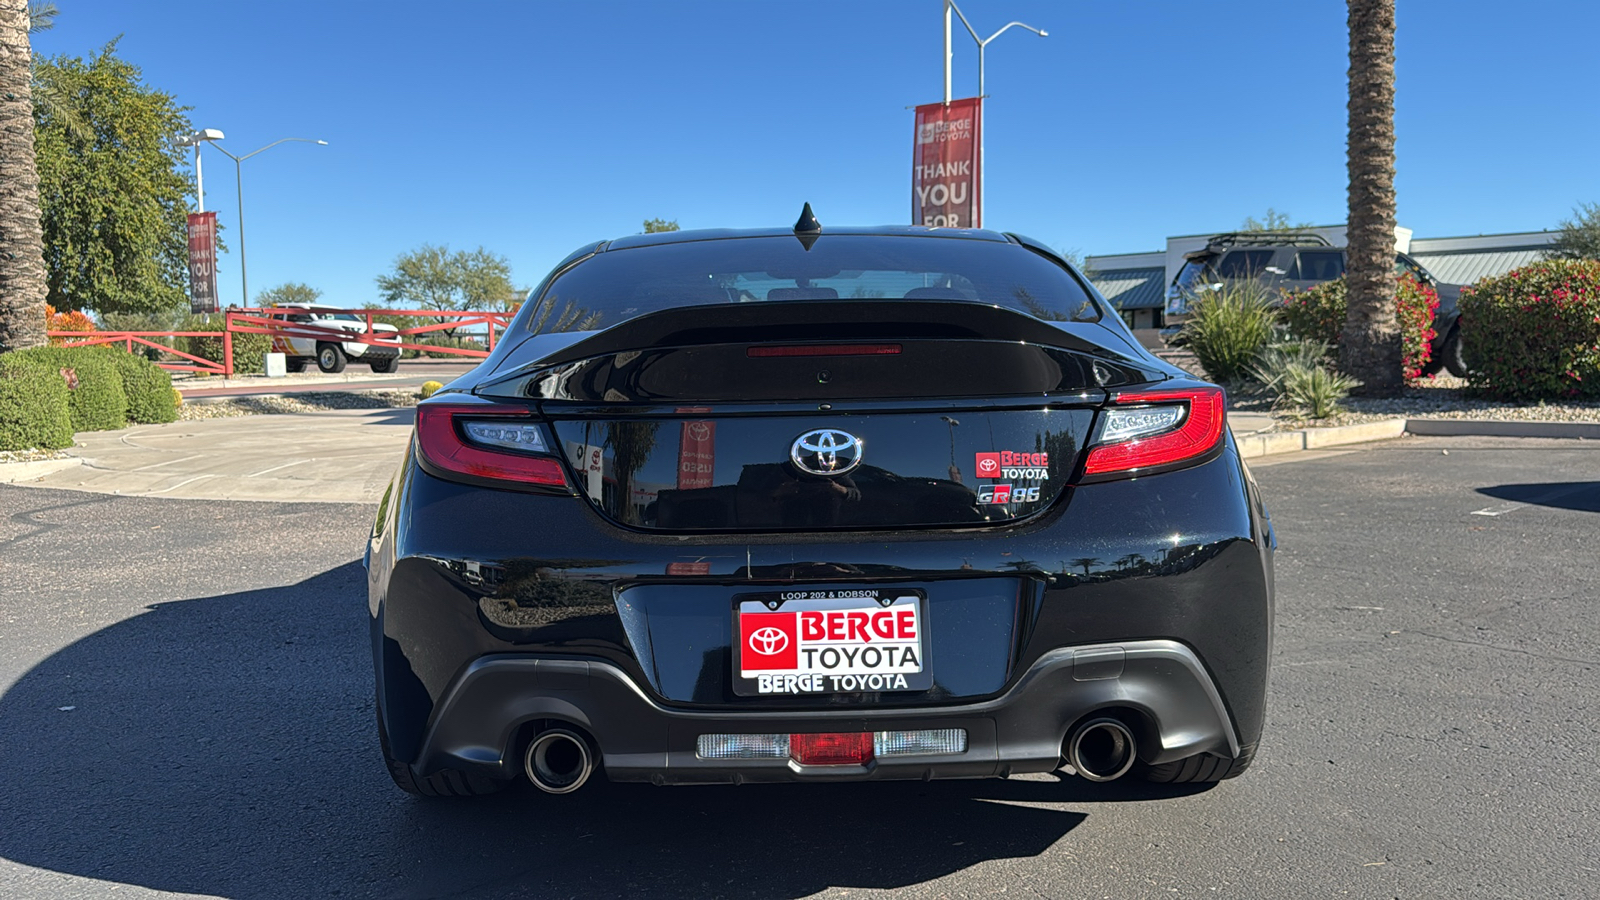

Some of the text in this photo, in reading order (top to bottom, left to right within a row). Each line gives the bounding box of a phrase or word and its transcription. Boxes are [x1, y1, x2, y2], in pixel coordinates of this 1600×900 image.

[935, 119, 971, 133] BERGE
[935, 131, 970, 142] TOYOTA
[916, 160, 970, 180] THANK
[916, 182, 967, 207] YOU
[924, 213, 959, 228] FOR
[190, 249, 210, 260] THANK
[190, 262, 210, 277] YOU
[193, 281, 208, 293] FOR
[1001, 451, 1049, 467] BERGE
[1002, 469, 1049, 480] TOYOTA
[781, 590, 879, 600] LOOP 202 & DOBSON
[801, 611, 916, 643] BERGE
[802, 646, 920, 669] TOYOTA
[758, 673, 908, 694] BERGE TOYOTA
